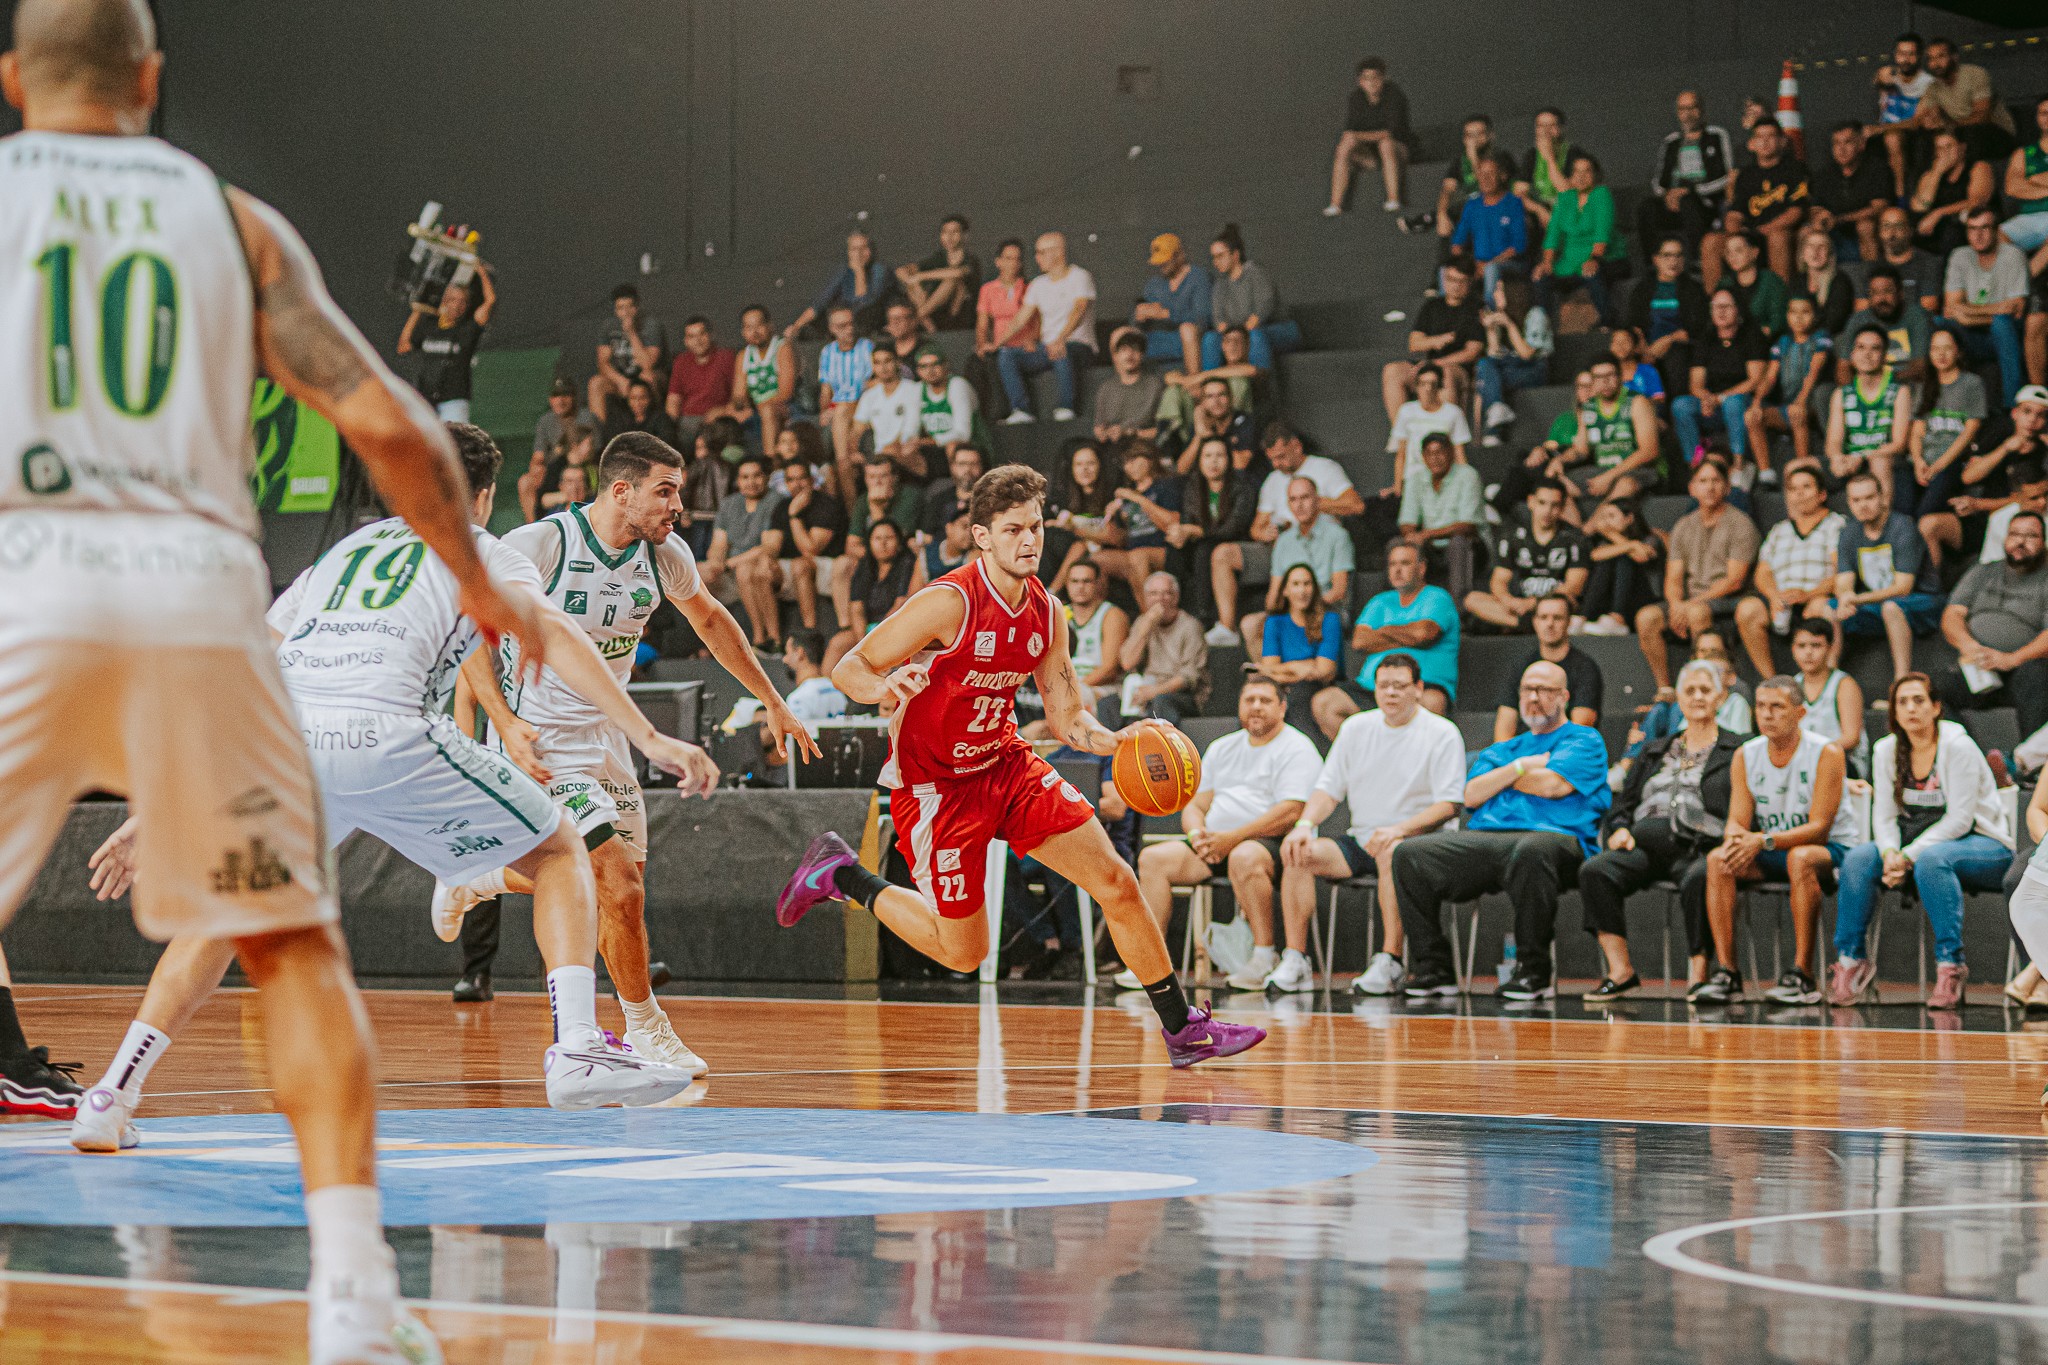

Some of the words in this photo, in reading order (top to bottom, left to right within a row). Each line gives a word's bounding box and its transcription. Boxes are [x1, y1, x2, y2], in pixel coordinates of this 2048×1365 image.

[33, 242, 181, 420] 10
[321, 541, 426, 612] 19
[316, 617, 407, 641] pagoufácil
[346, 718, 376, 729] grupo
[967, 695, 1006, 733] 22
[938, 873, 968, 902] 22
